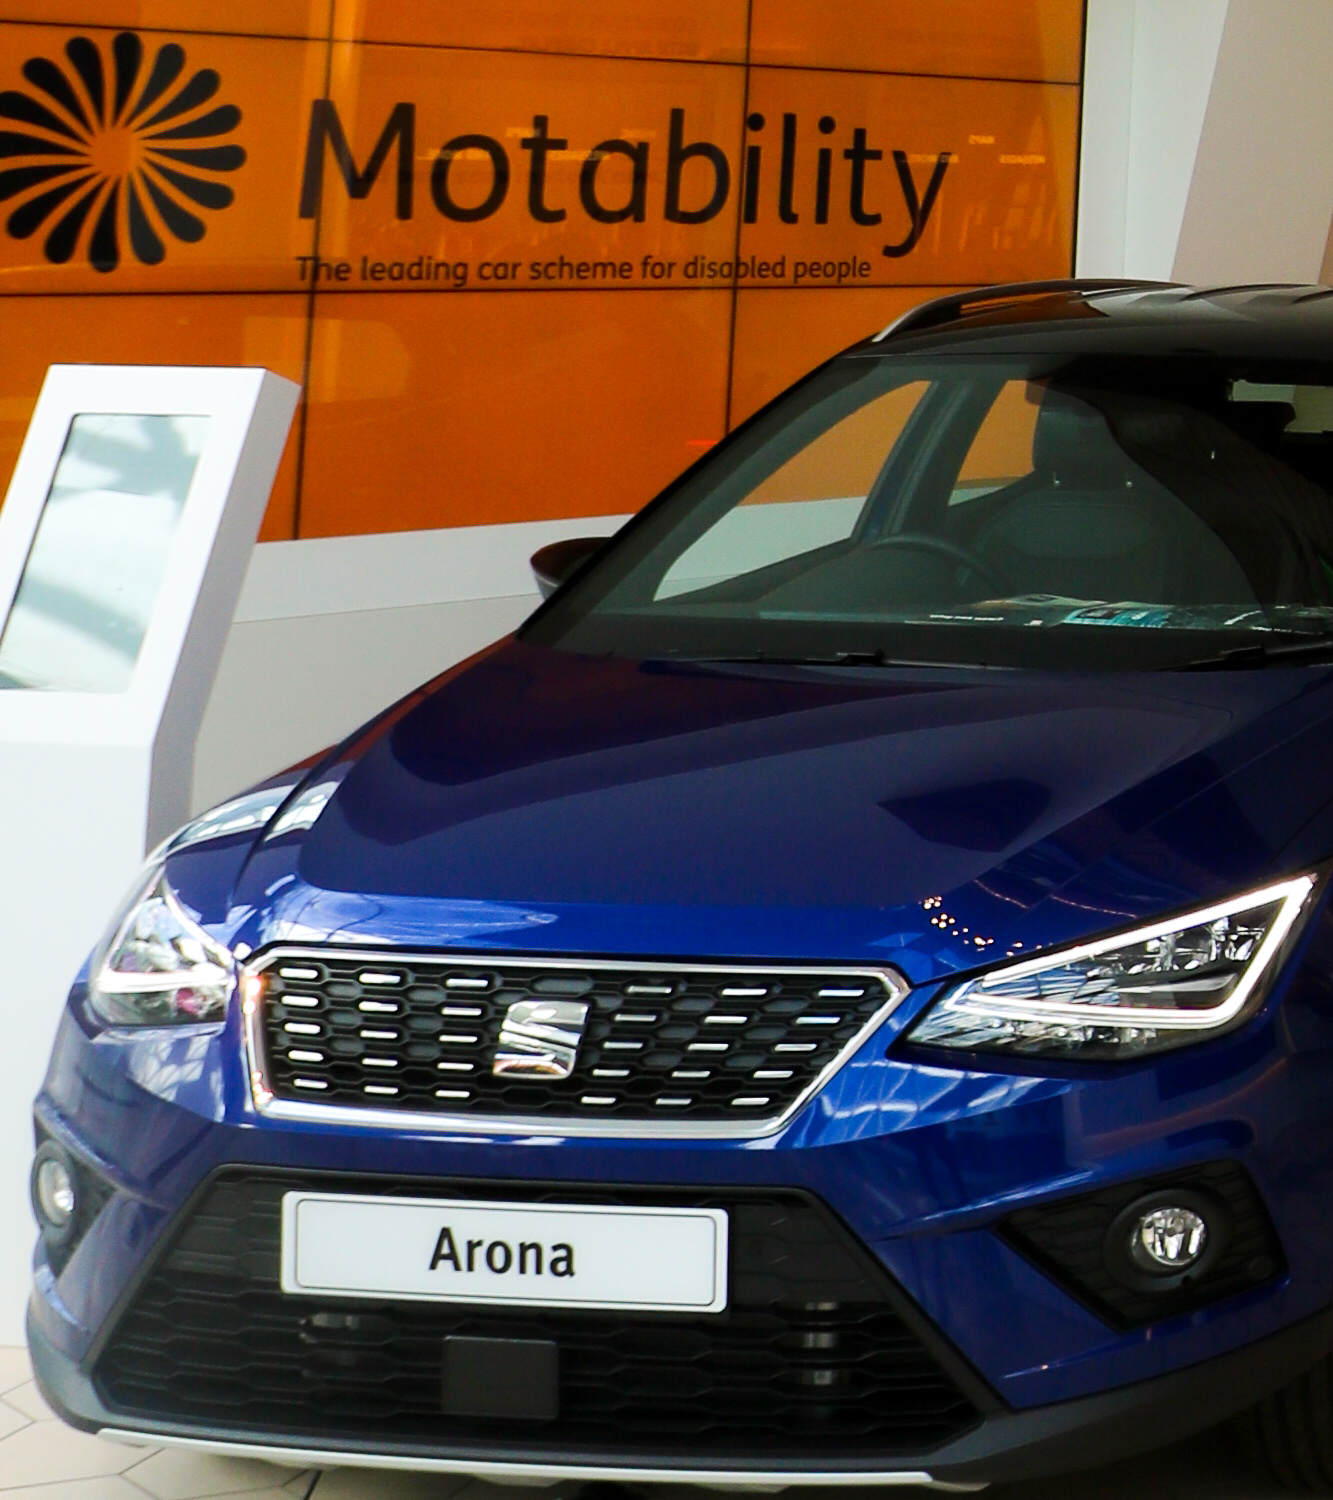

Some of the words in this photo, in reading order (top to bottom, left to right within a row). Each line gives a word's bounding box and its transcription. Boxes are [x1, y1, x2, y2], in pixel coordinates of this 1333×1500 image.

[298, 98, 952, 258] Motability
[295, 255, 351, 282] The
[361, 255, 469, 288] leading
[478, 261, 522, 281] car
[530, 255, 633, 280] scheme
[641, 254, 677, 280] for
[683, 254, 787, 280] disabled
[793, 255, 872, 285] people
[428, 1226, 576, 1277] Arona
